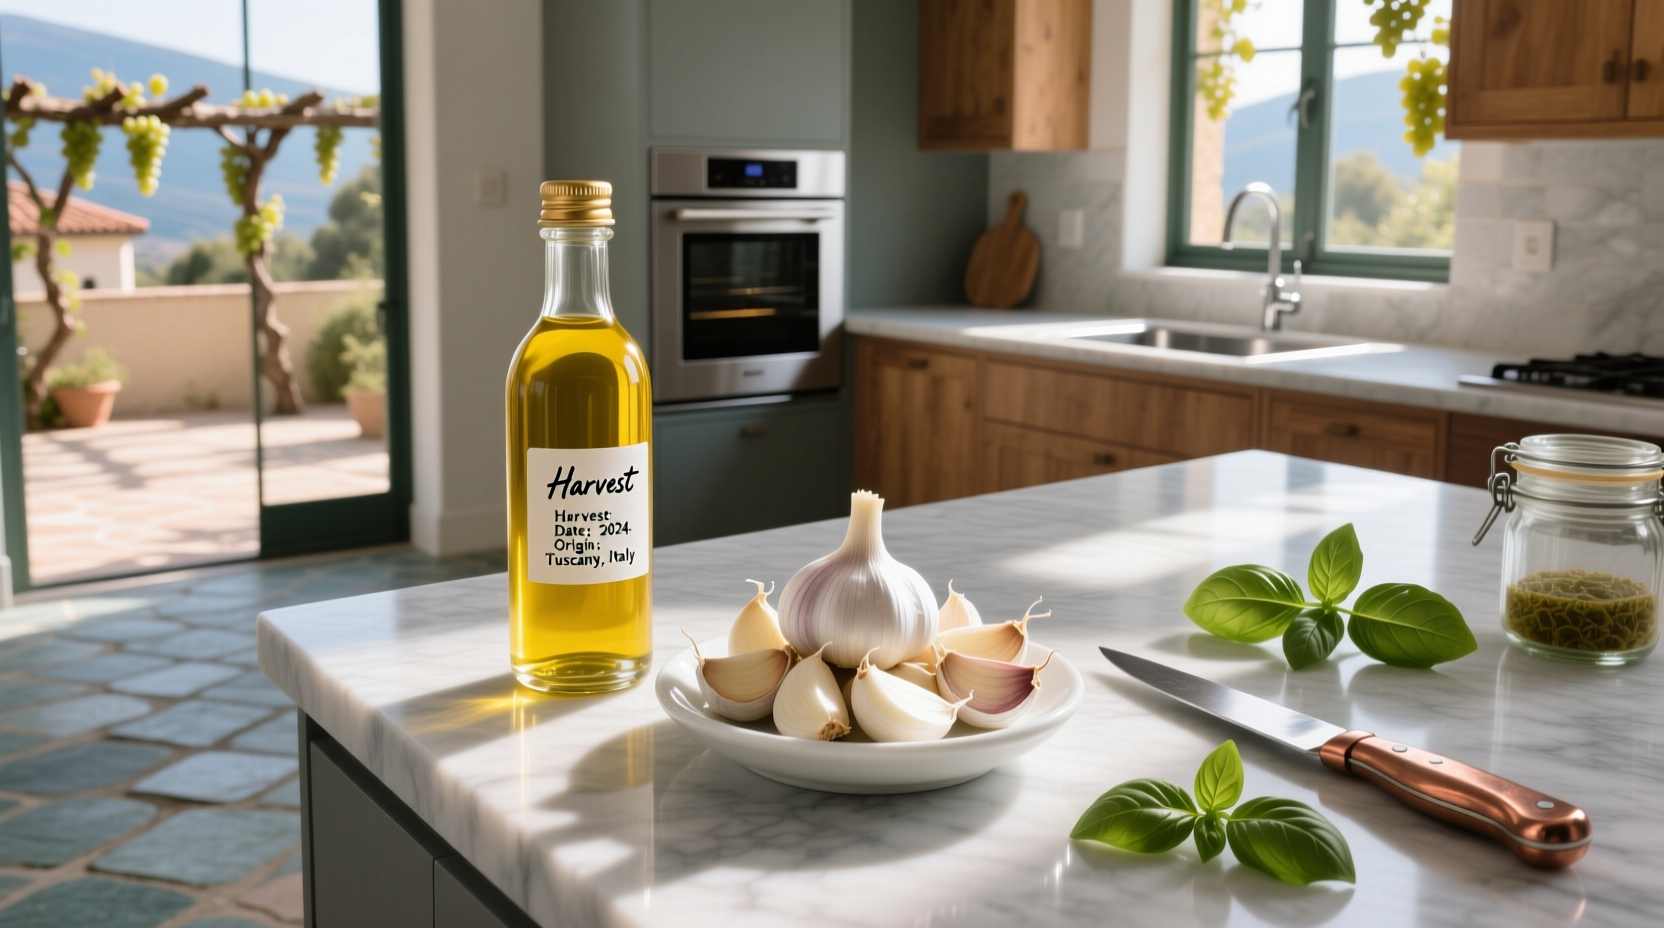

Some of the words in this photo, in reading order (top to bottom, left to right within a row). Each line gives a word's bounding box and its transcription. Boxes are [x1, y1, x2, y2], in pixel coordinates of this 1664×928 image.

[547, 466, 639, 500] Harvest
[555, 525, 591, 537] Date:
[554, 538, 600, 554] Origin:
[545, 553, 605, 568] Tuscany,
[609, 548, 635, 565] Italy
